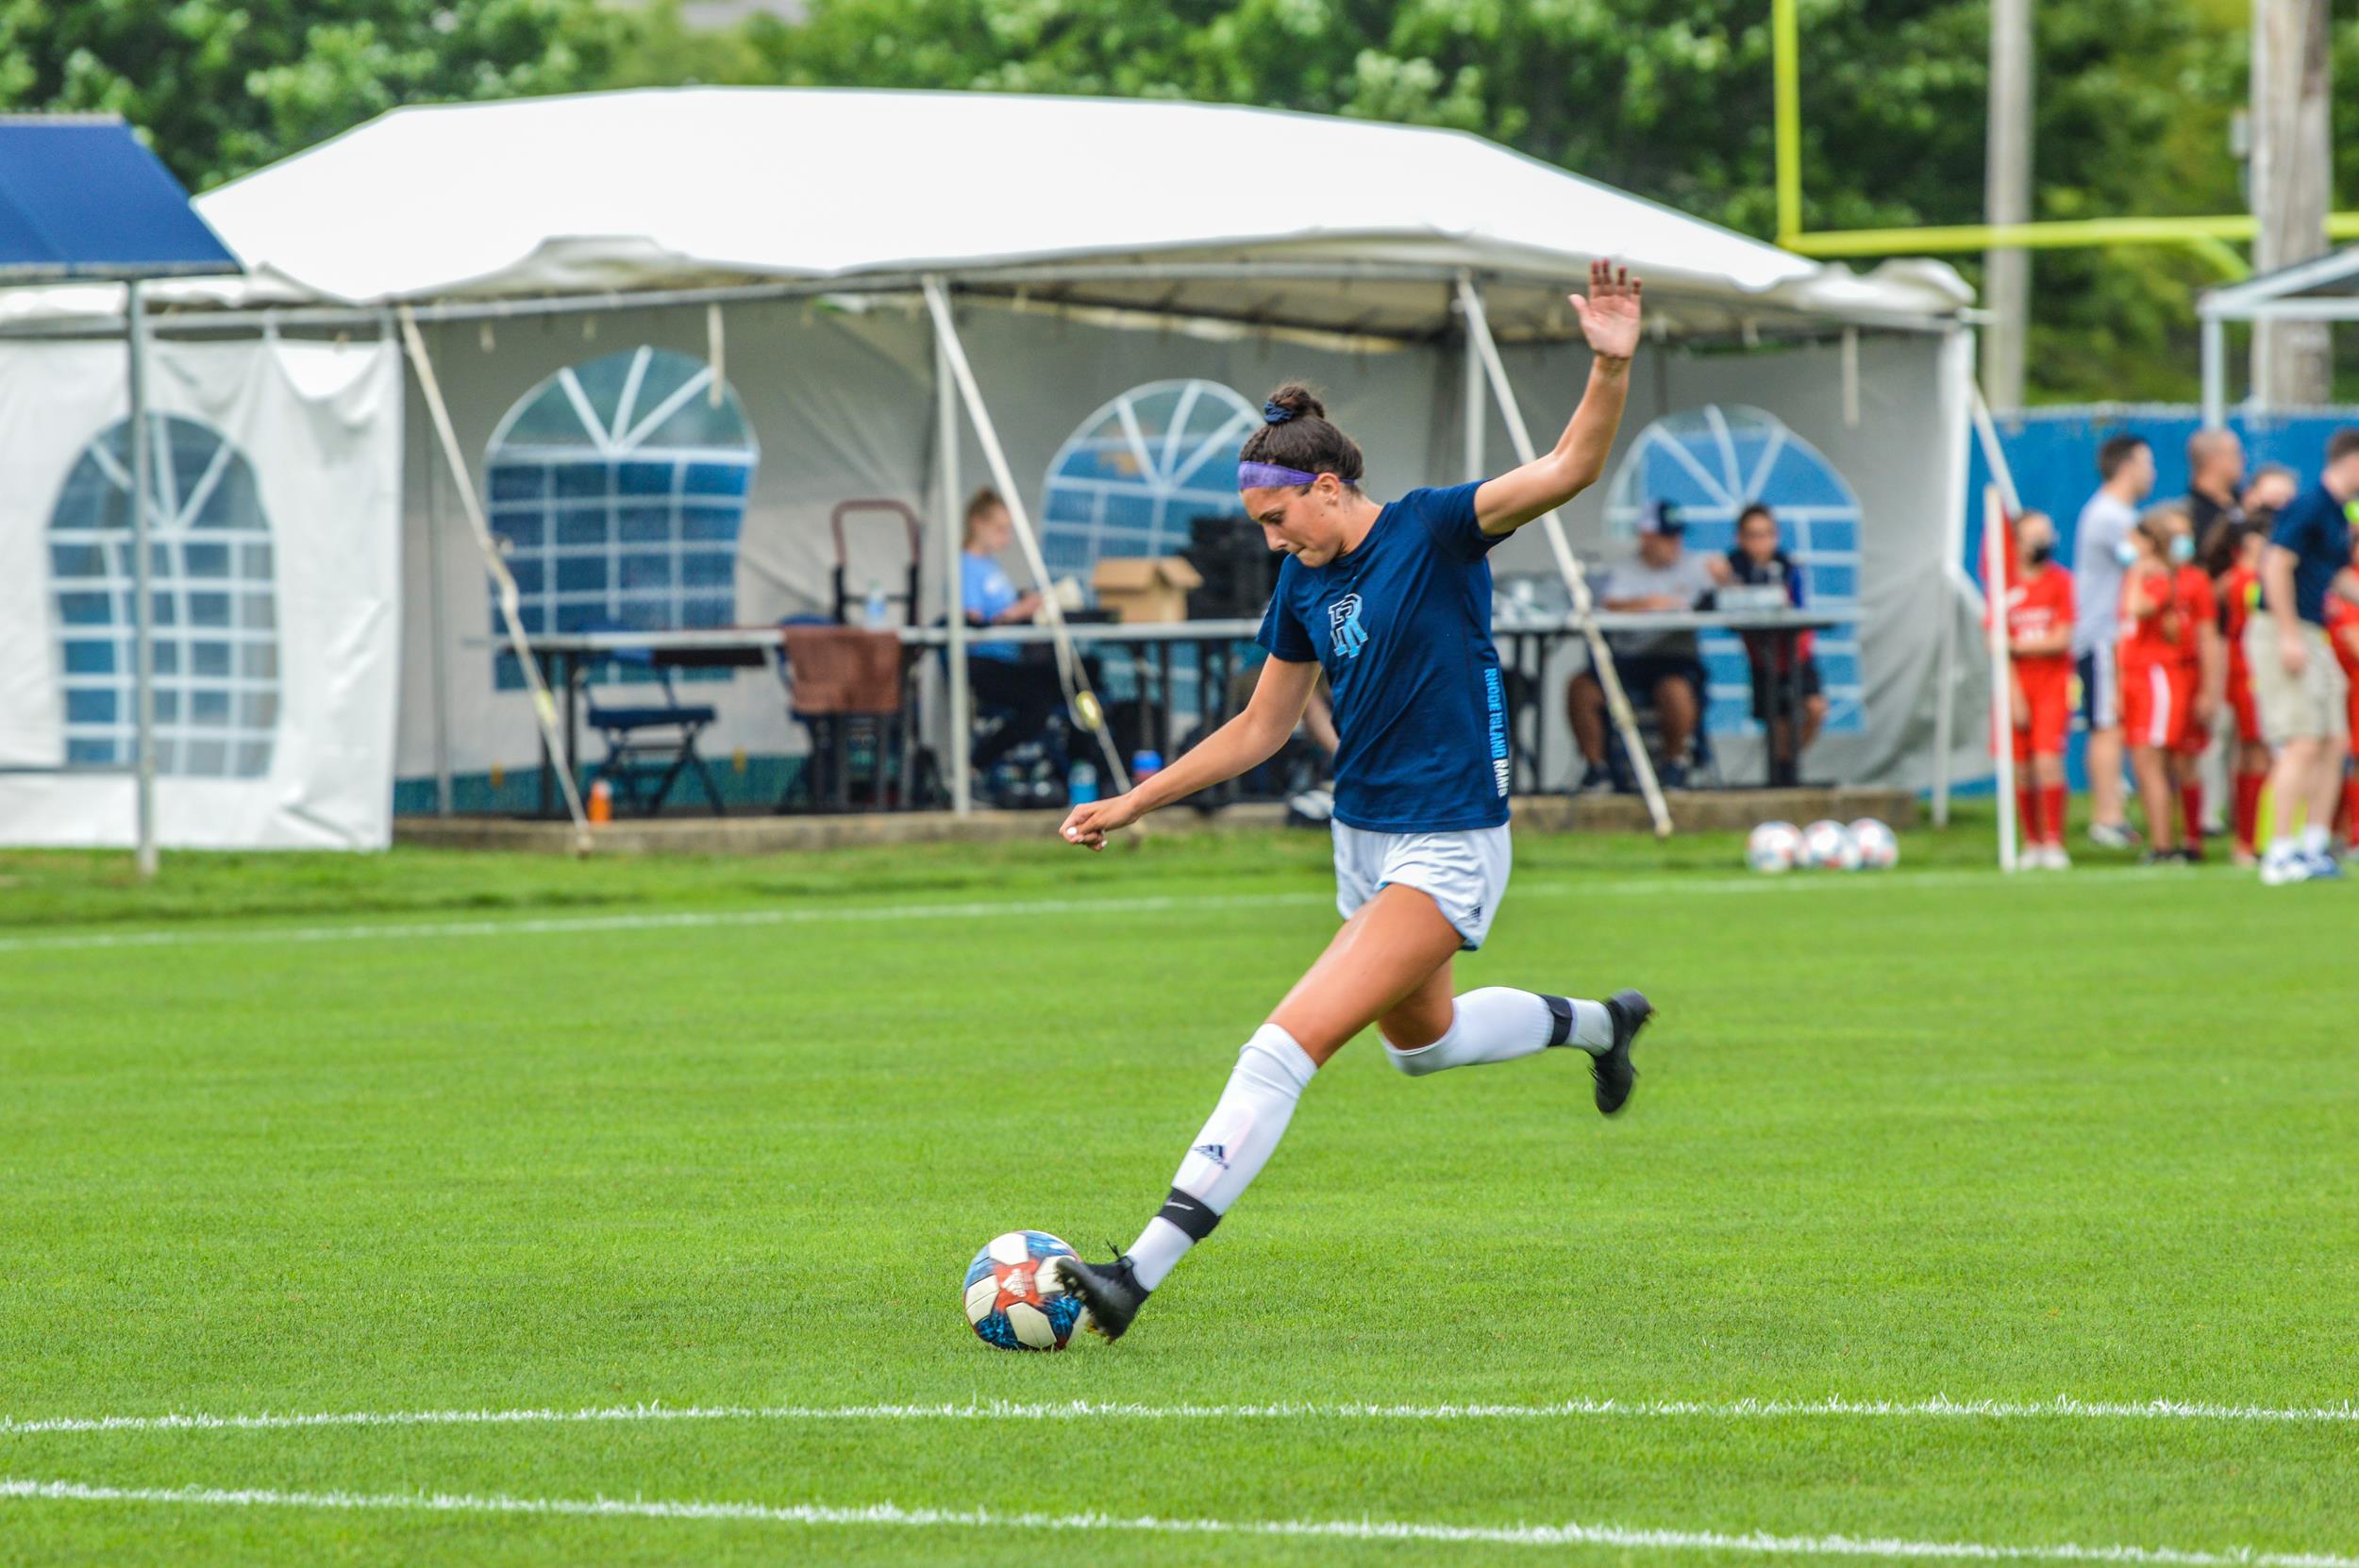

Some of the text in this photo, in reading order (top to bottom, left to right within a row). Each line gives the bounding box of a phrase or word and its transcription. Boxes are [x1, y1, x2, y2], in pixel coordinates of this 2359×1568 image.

[1484, 667, 1510, 798] RHODE ISLAND RAMS
